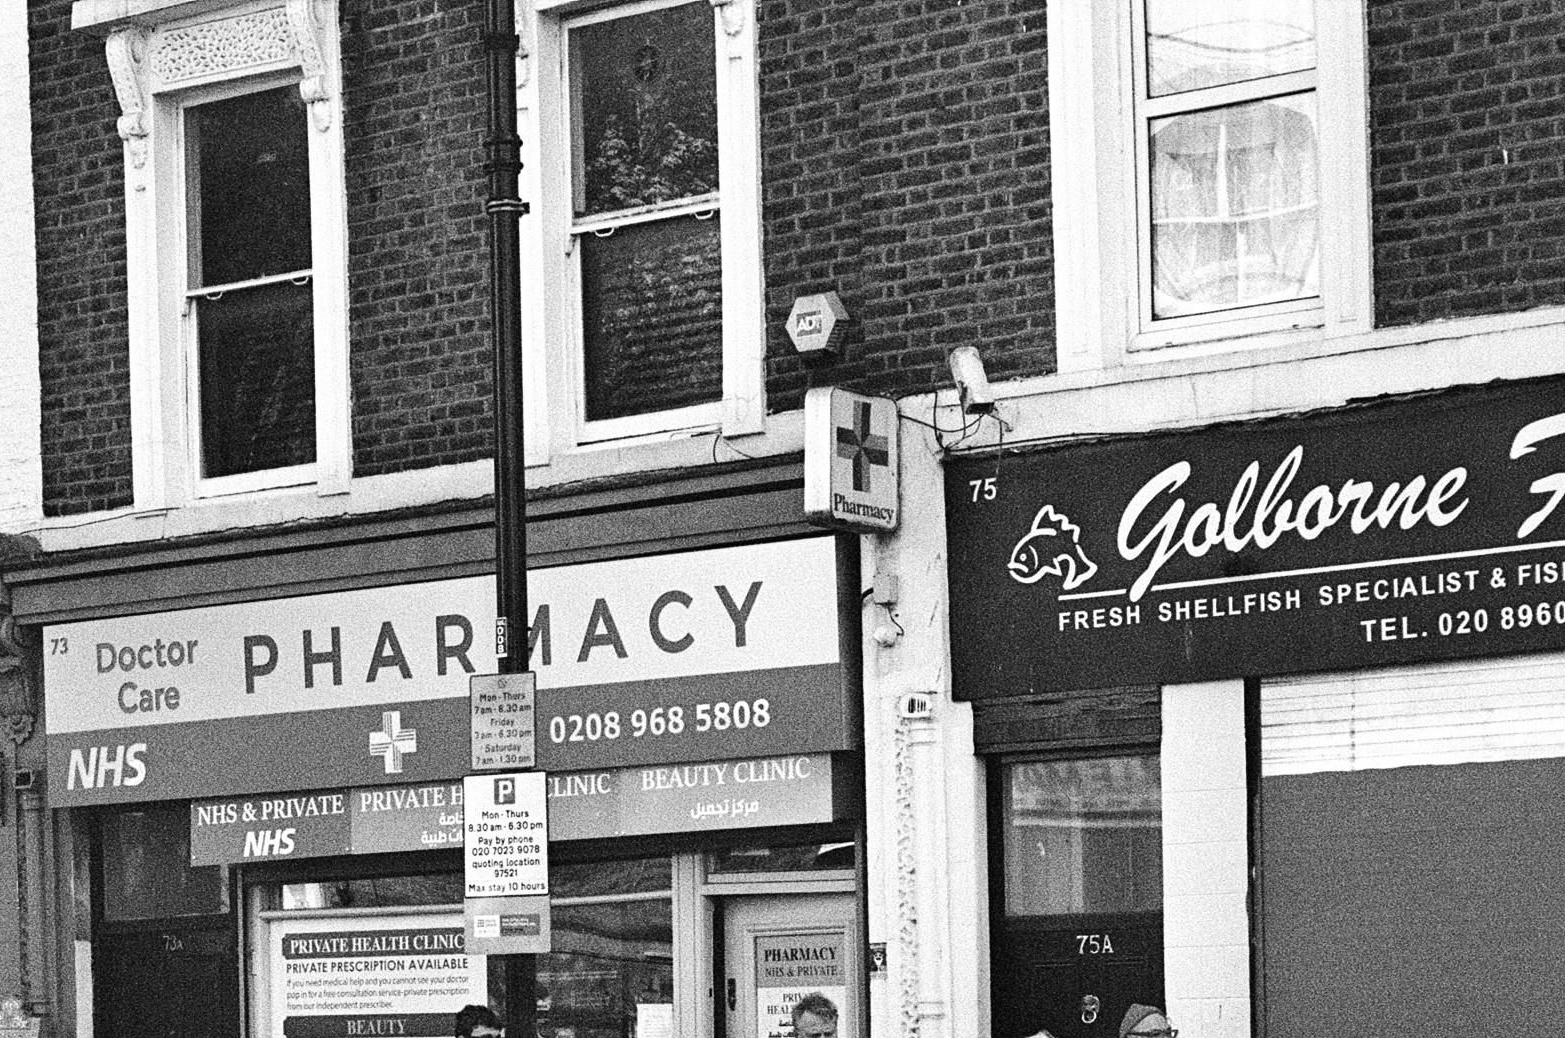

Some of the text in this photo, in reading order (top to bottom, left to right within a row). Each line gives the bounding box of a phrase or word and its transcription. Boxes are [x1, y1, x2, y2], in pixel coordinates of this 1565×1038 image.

[969, 477, 997, 502] 75
[834, 493, 894, 525] Pharmacy
[1117, 445, 1470, 601] Golborne
[1058, 561, 1565, 631] FRESH SHELLFISH SPECIALIST & FIS
[1359, 600, 1565, 643] TEL. 020 8960
[50, 637, 69, 656] 73
[95, 639, 198, 674] Doctor
[117, 681, 181, 714] Care
[490, 717, 515, 727] Friday
[549, 698, 771, 743] 0208 968 5808
[485, 743, 522, 754] Saturday
[67, 743, 147, 790] NHS
[640, 757, 812, 791] BEAUTY CLINIC
[360, 786, 446, 812] PRIVATE
[498, 780, 513, 803] P
[196, 794, 345, 826] NHS & PRIVATE
[482, 809, 529, 820] Mon Thurs
[468, 821, 544, 833] 8.30 am 6.30 pm
[243, 828, 296, 857] NHS
[478, 835, 534, 846] Pay by phone
[471, 844, 541, 857] 020 7023 9078
[472, 857, 541, 869] quoting location
[494, 869, 518, 878] 97521
[468, 881, 546, 893] Max stay 10 hours
[290, 933, 465, 954] PRIVATE HEALTH CLINIC
[1076, 934, 1114, 955] 75A
[764, 946, 837, 962] PHARMACY
[286, 957, 468, 974] PRIVATE PRESCRIPTION AVAILABLE
[765, 966, 784, 977] NHS
[797, 964, 837, 977] PRIVATE
[322, 977, 348, 986] medical
[349, 977, 364, 988] help
[446, 974, 469, 984] doctor
[336, 988, 377, 998] consultation
[428, 987, 470, 997] prescription
[783, 993, 802, 1003] PRIV
[316, 1001, 357, 1010] independent
[346, 1019, 407, 1035] BEAUTY
